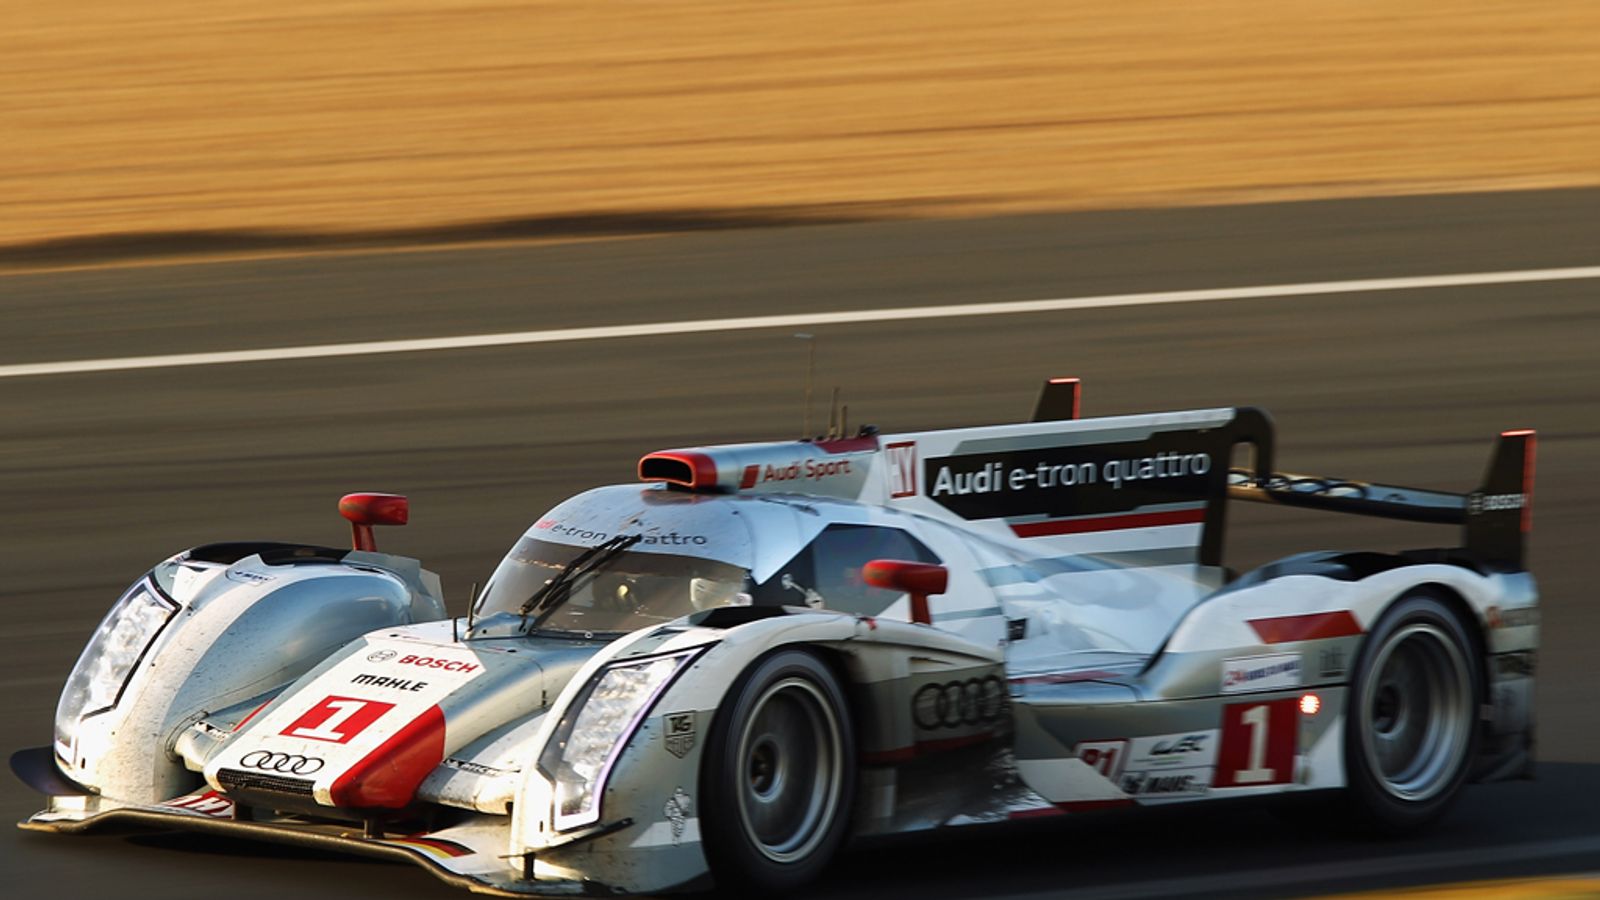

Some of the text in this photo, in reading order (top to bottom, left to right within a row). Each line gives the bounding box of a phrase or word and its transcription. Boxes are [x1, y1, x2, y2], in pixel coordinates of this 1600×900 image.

[764, 458, 852, 482] Audi Sport
[932, 452, 1211, 496] Audi e-tron quattro
[551, 524, 607, 541] e-tron
[398, 654, 479, 674] BOSCH
[351, 673, 429, 692] MAHLE
[291, 700, 368, 740] 1
[1234, 704, 1275, 784] 1
